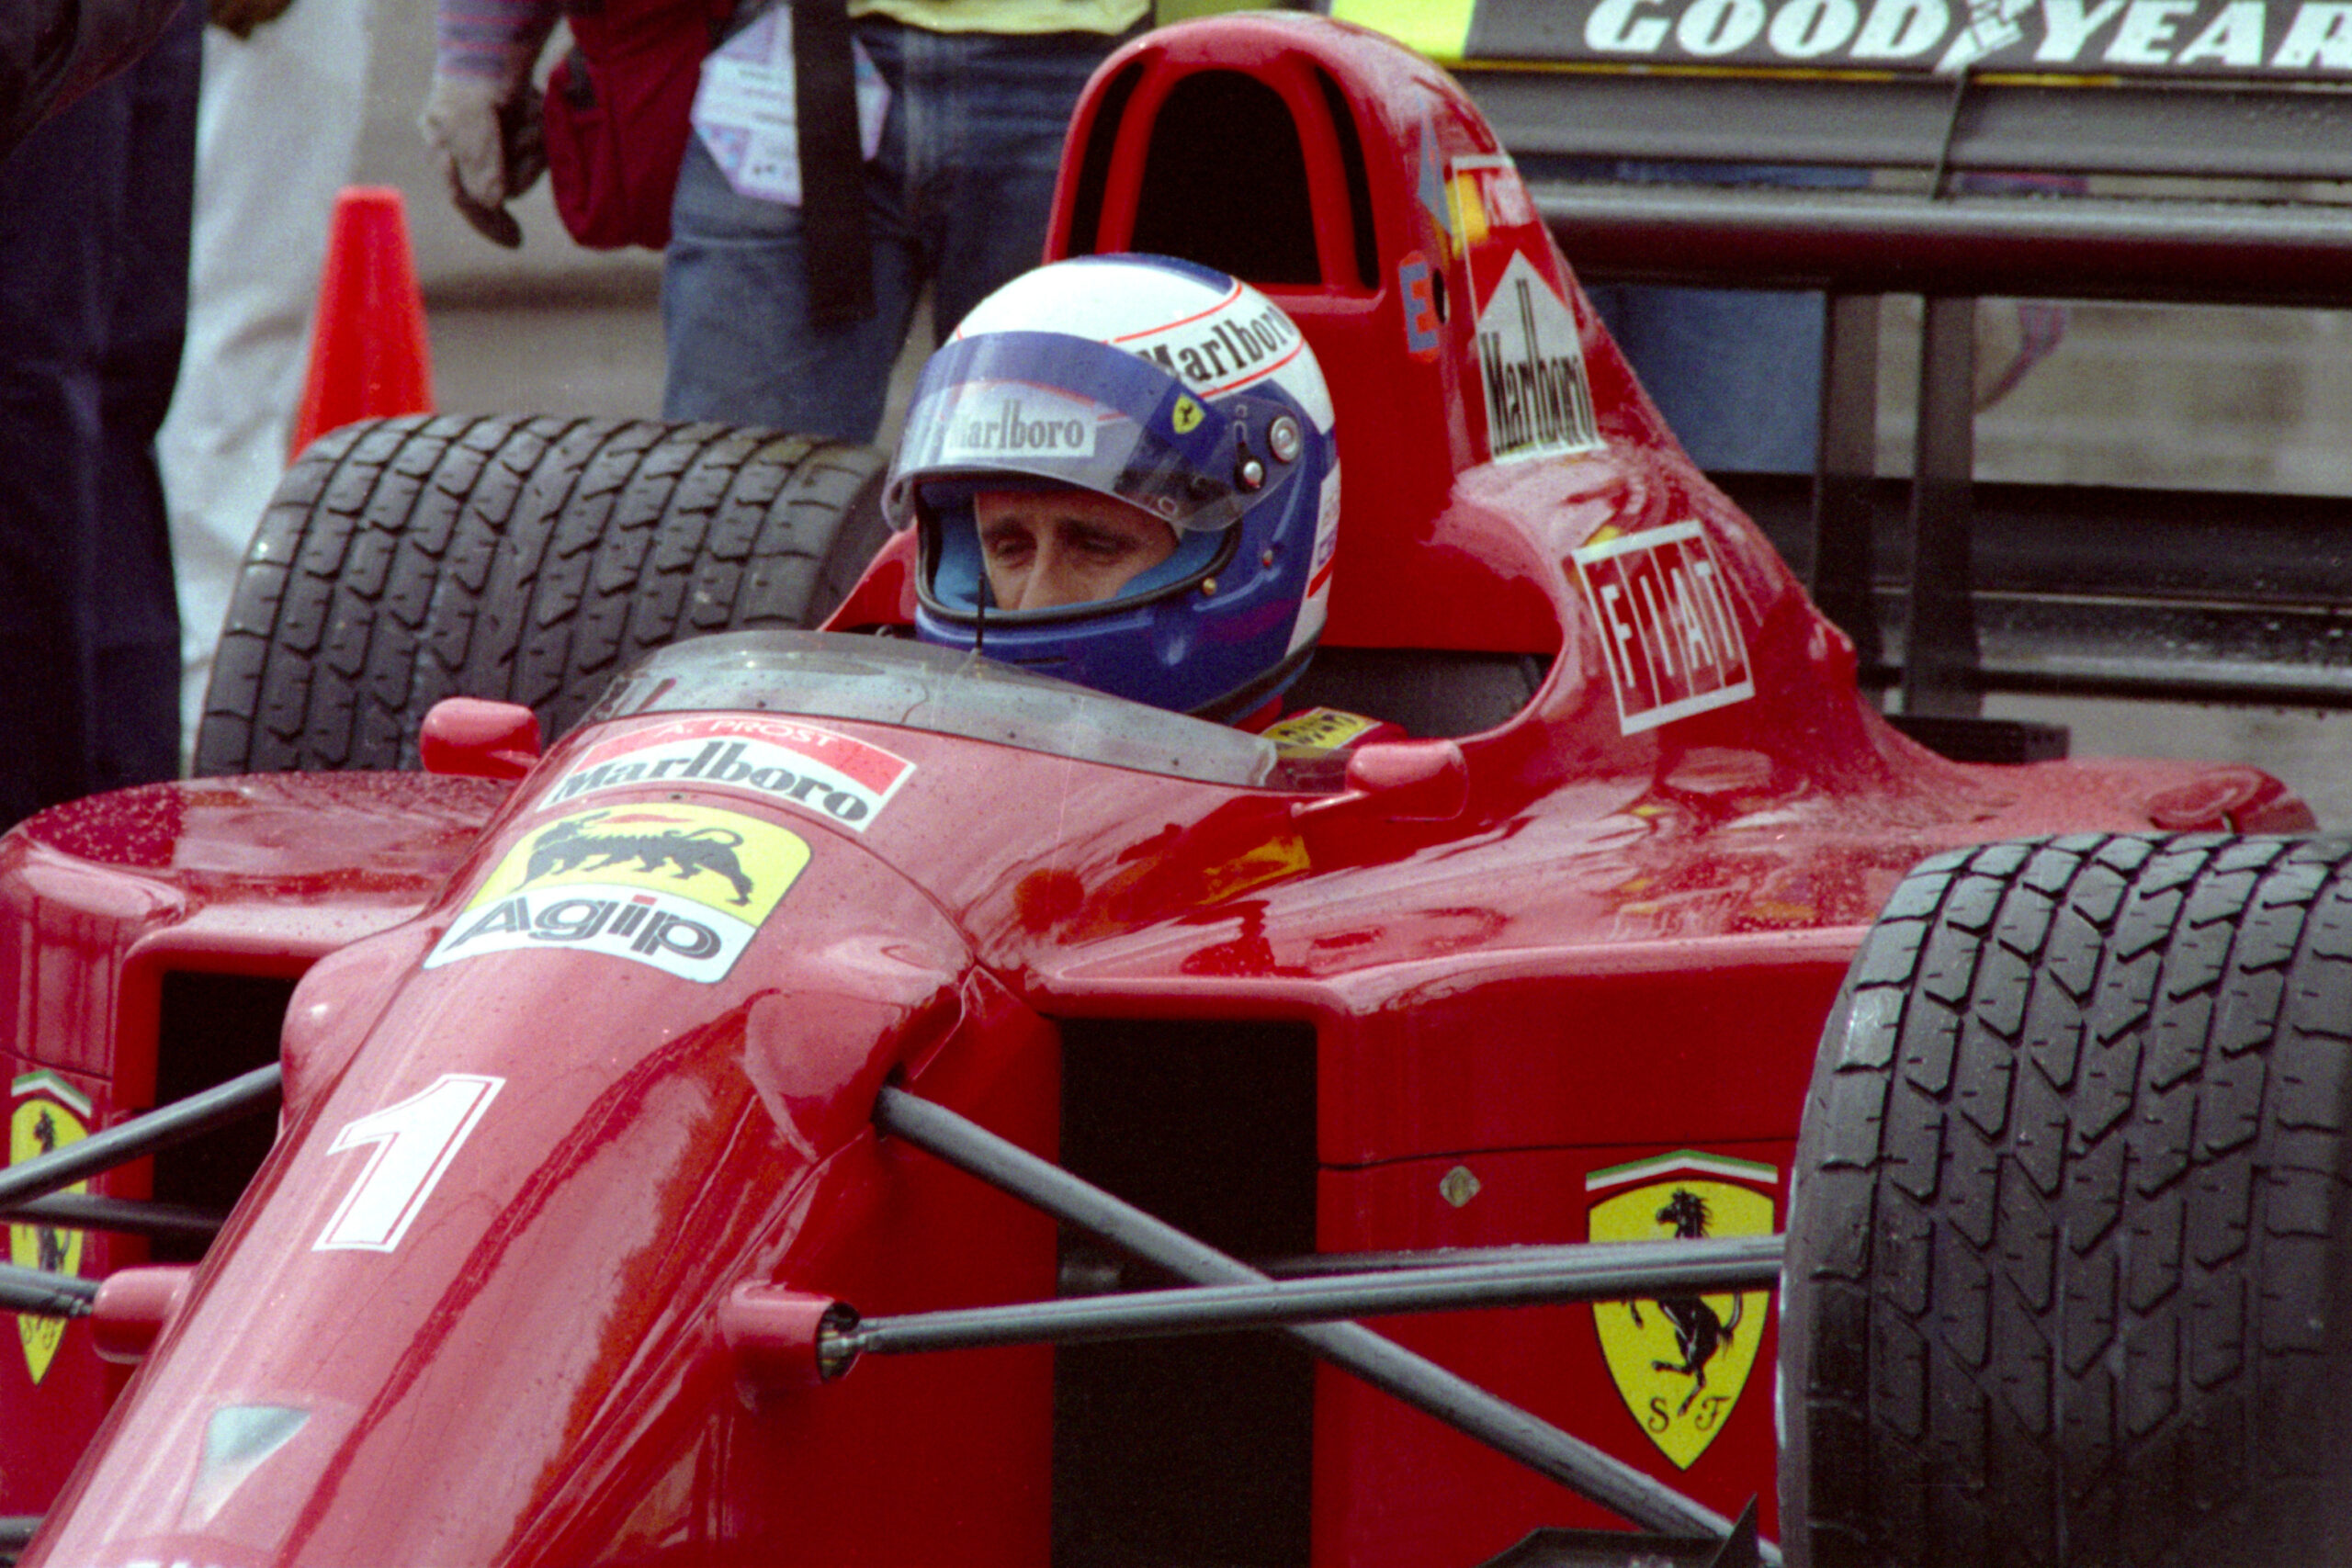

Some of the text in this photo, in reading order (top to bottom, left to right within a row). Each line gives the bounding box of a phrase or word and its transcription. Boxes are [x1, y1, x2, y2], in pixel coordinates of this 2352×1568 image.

[1583, 0, 2352, 68] GOOD YEAR
[1399, 262, 1439, 352] E
[1601, 560, 1736, 686] FIAT
[711, 719, 838, 747] PROST
[550, 740, 868, 821] Marlboro
[441, 896, 722, 961] Agip
[311, 1073, 507, 1253] 1
[1647, 1396, 1669, 1434] S
